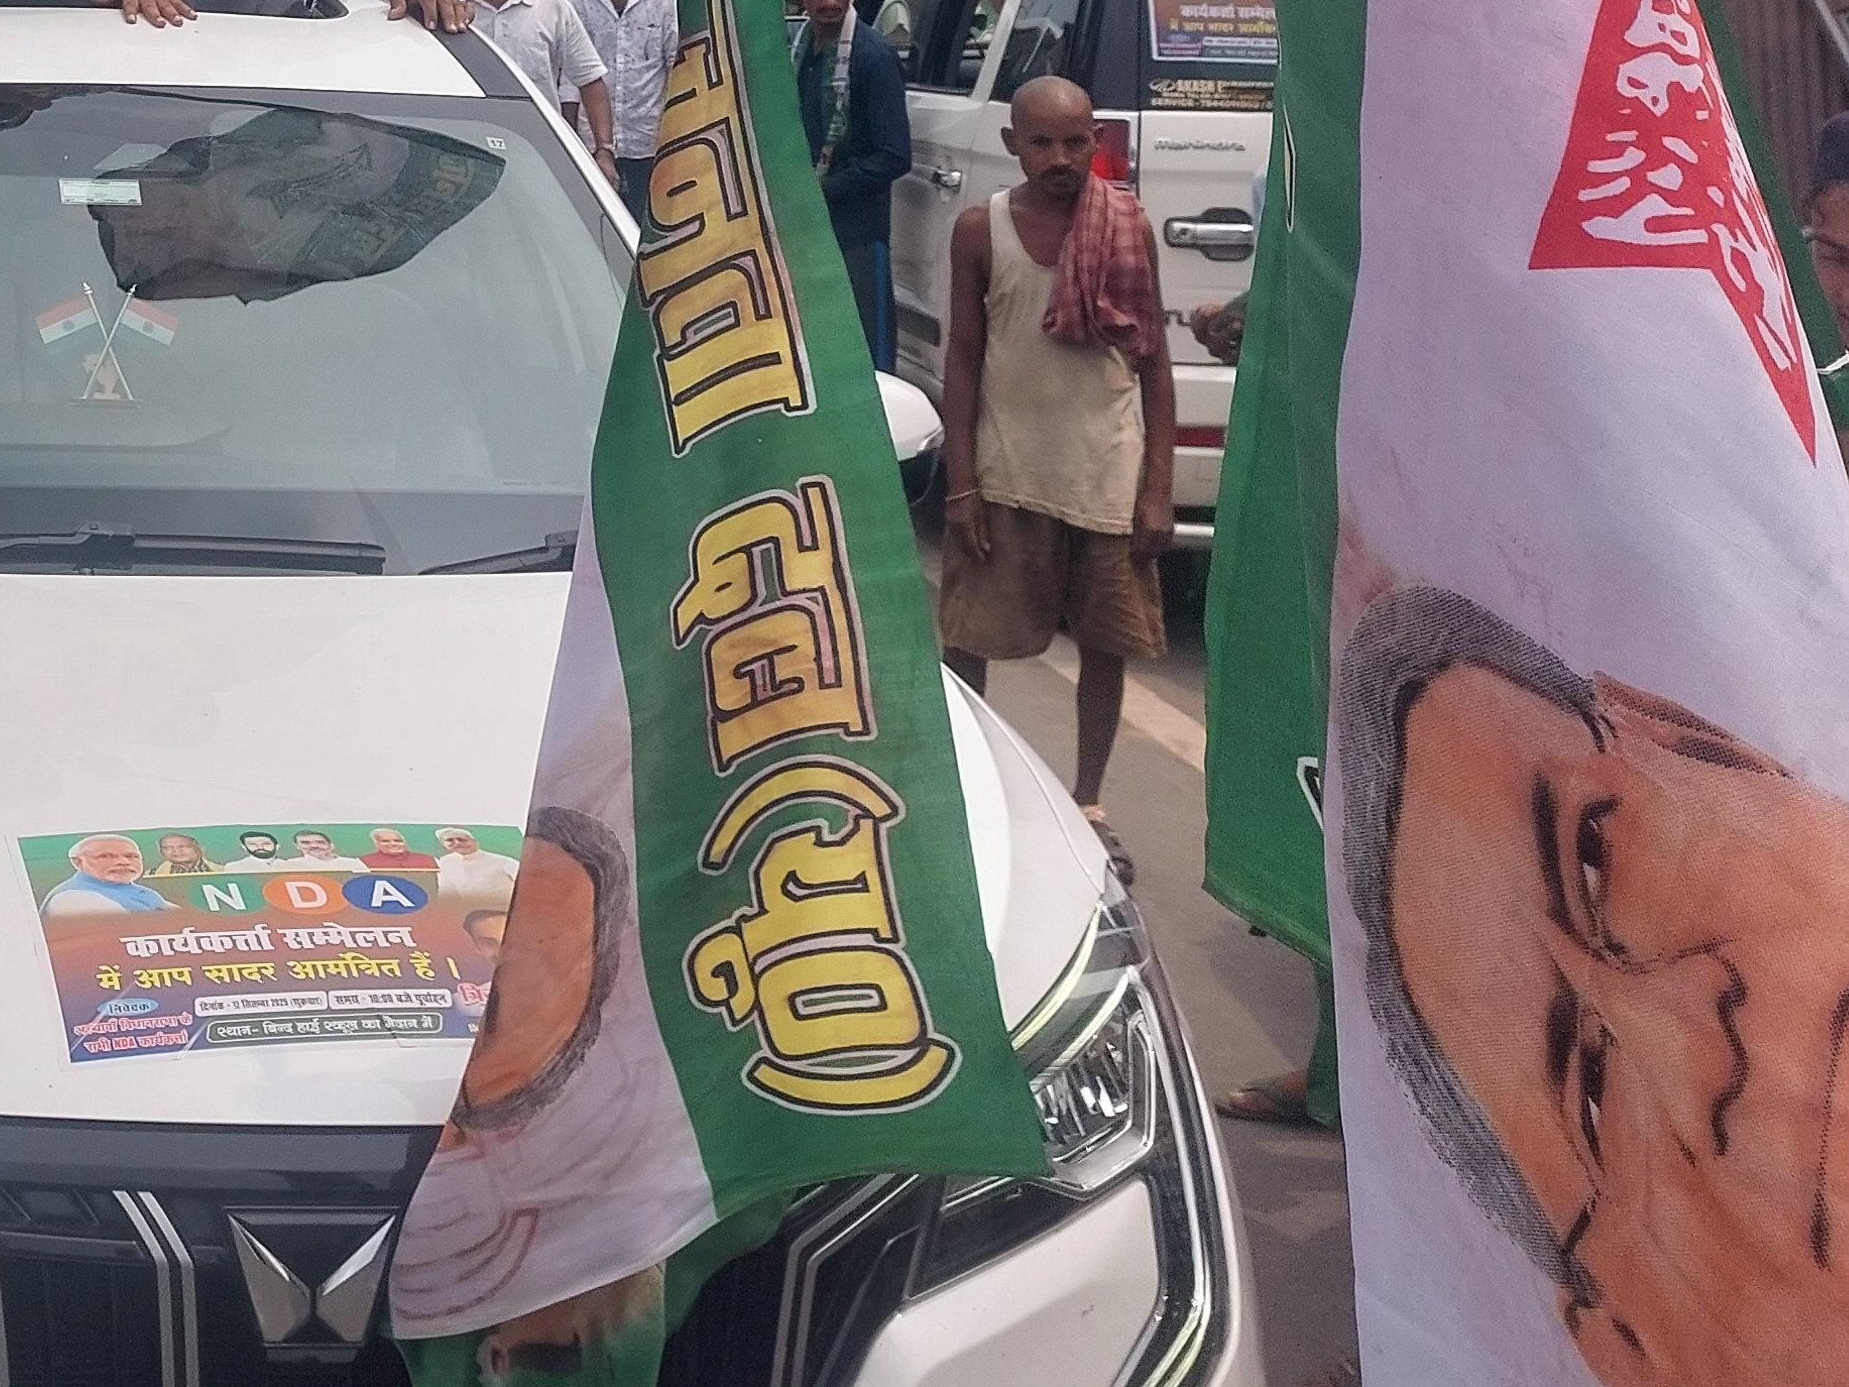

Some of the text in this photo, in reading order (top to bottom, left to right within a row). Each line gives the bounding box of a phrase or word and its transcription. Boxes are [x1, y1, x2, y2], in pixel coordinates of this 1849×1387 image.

[672, 474, 877, 774] दल
[276, 922, 418, 952] सम्मेलन
[684, 755, 962, 1115] (यू०)
[96, 965, 121, 991] में
[132, 966, 192, 990] आप
[200, 962, 279, 985] सादर
[286, 951, 402, 980] आमंत्रित
[409, 949, 436, 980] हैं
[109, 1003, 150, 1014] निवेदक
[335, 995, 360, 1005] समय
[178, 1012, 193, 1025] के
[113, 1037, 137, 1050] NDA
